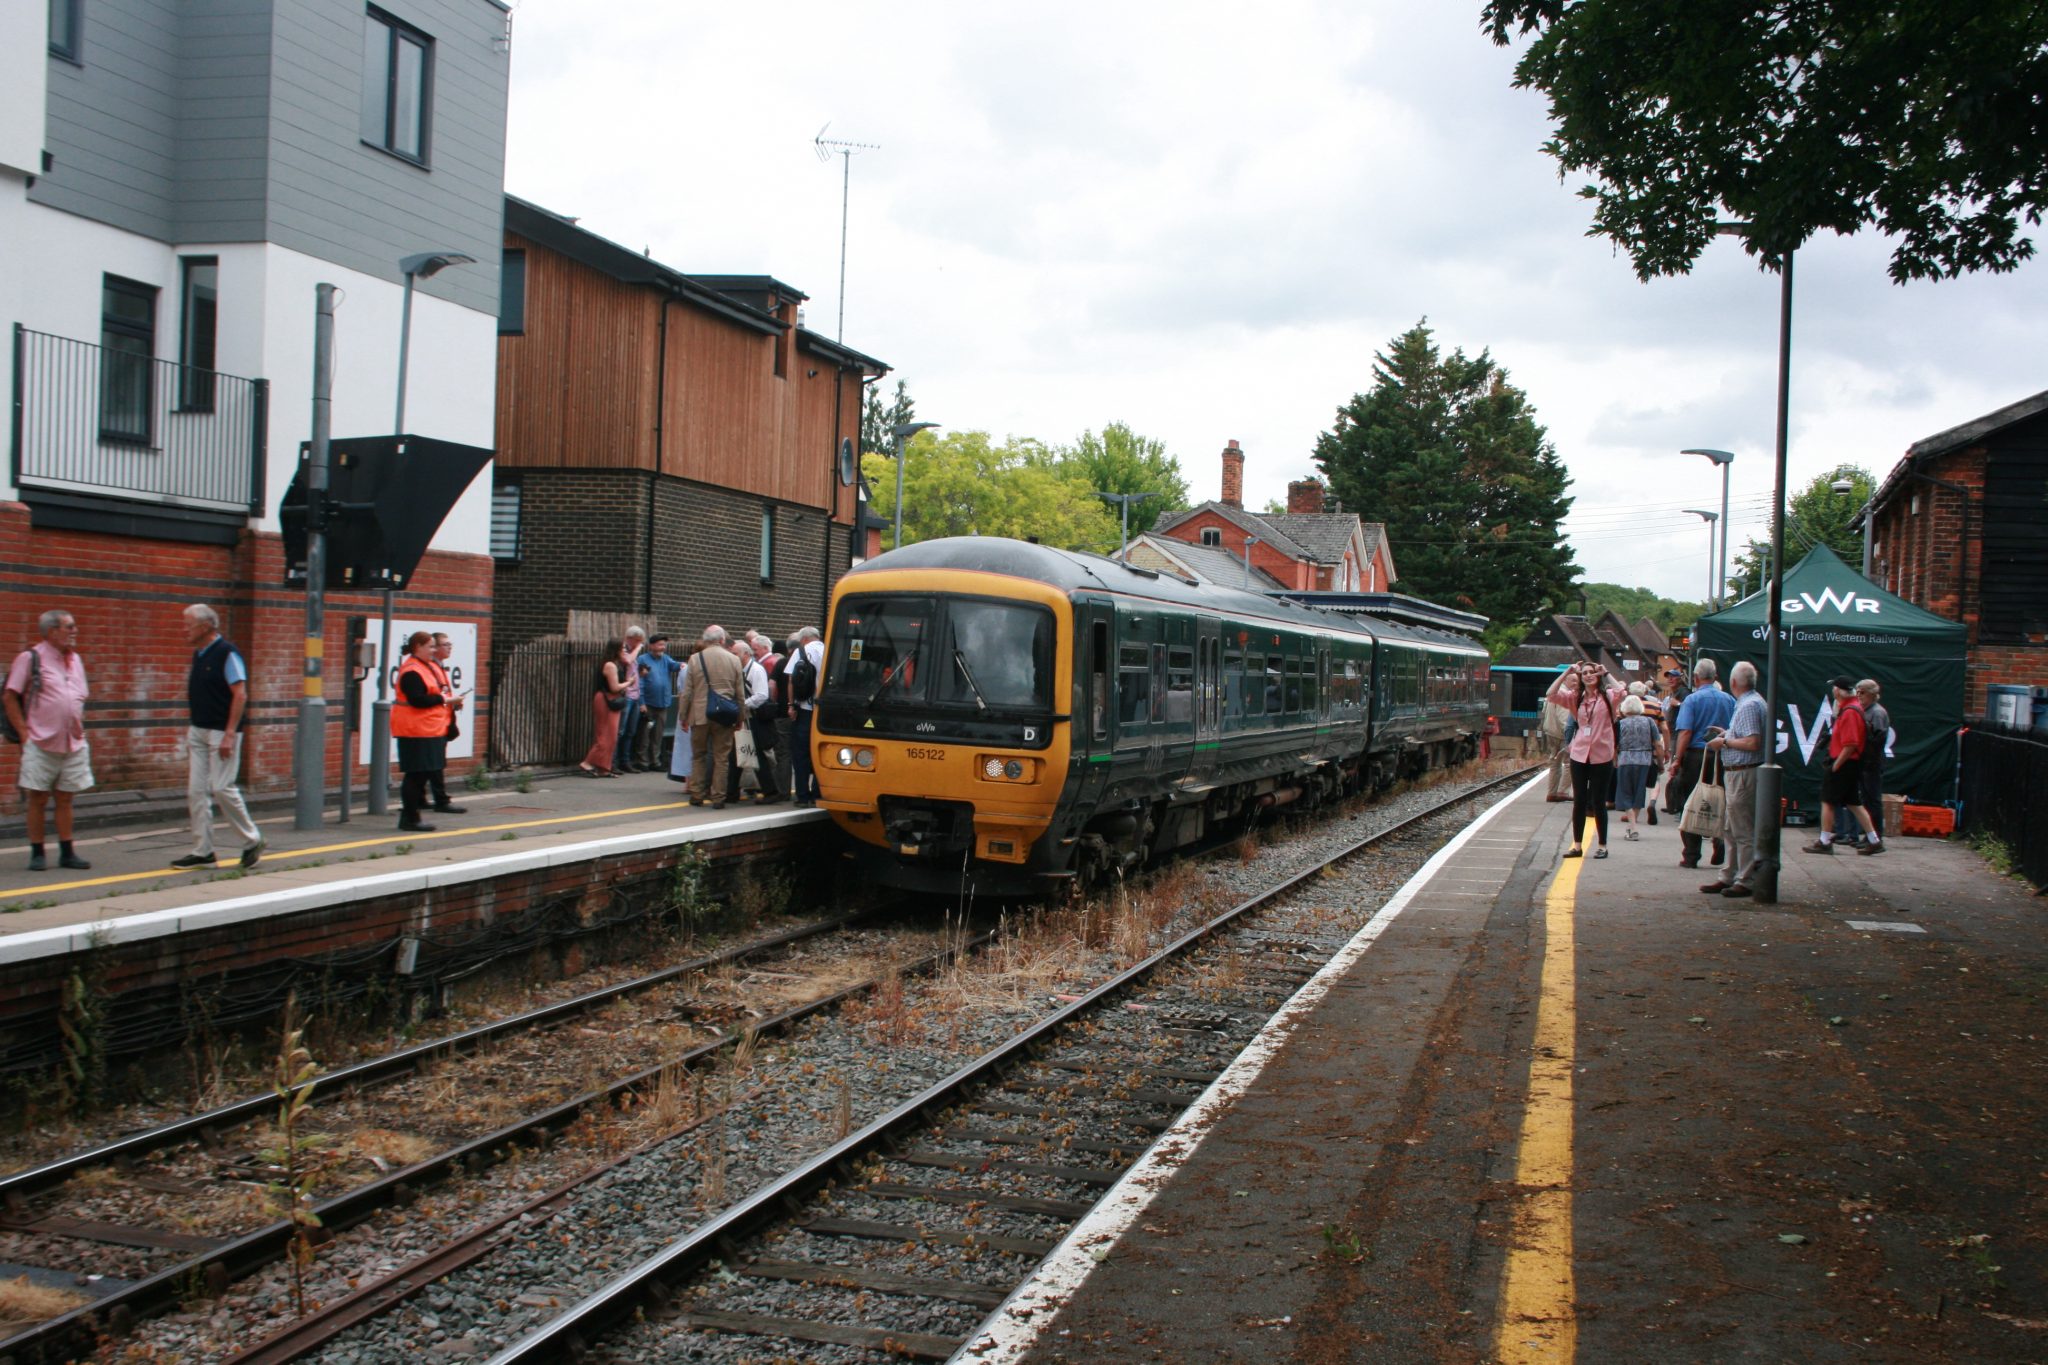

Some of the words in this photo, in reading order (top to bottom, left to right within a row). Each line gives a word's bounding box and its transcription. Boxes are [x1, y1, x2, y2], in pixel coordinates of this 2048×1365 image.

[1780, 586, 1880, 614] GWR
[1796, 632, 1823, 641] Great
[1826, 633, 1866, 643] Western
[1869, 634, 1909, 646] Railway
[916, 722, 936, 732] GWR
[1024, 728, 1036, 741] D
[906, 748, 945, 760] 165122
